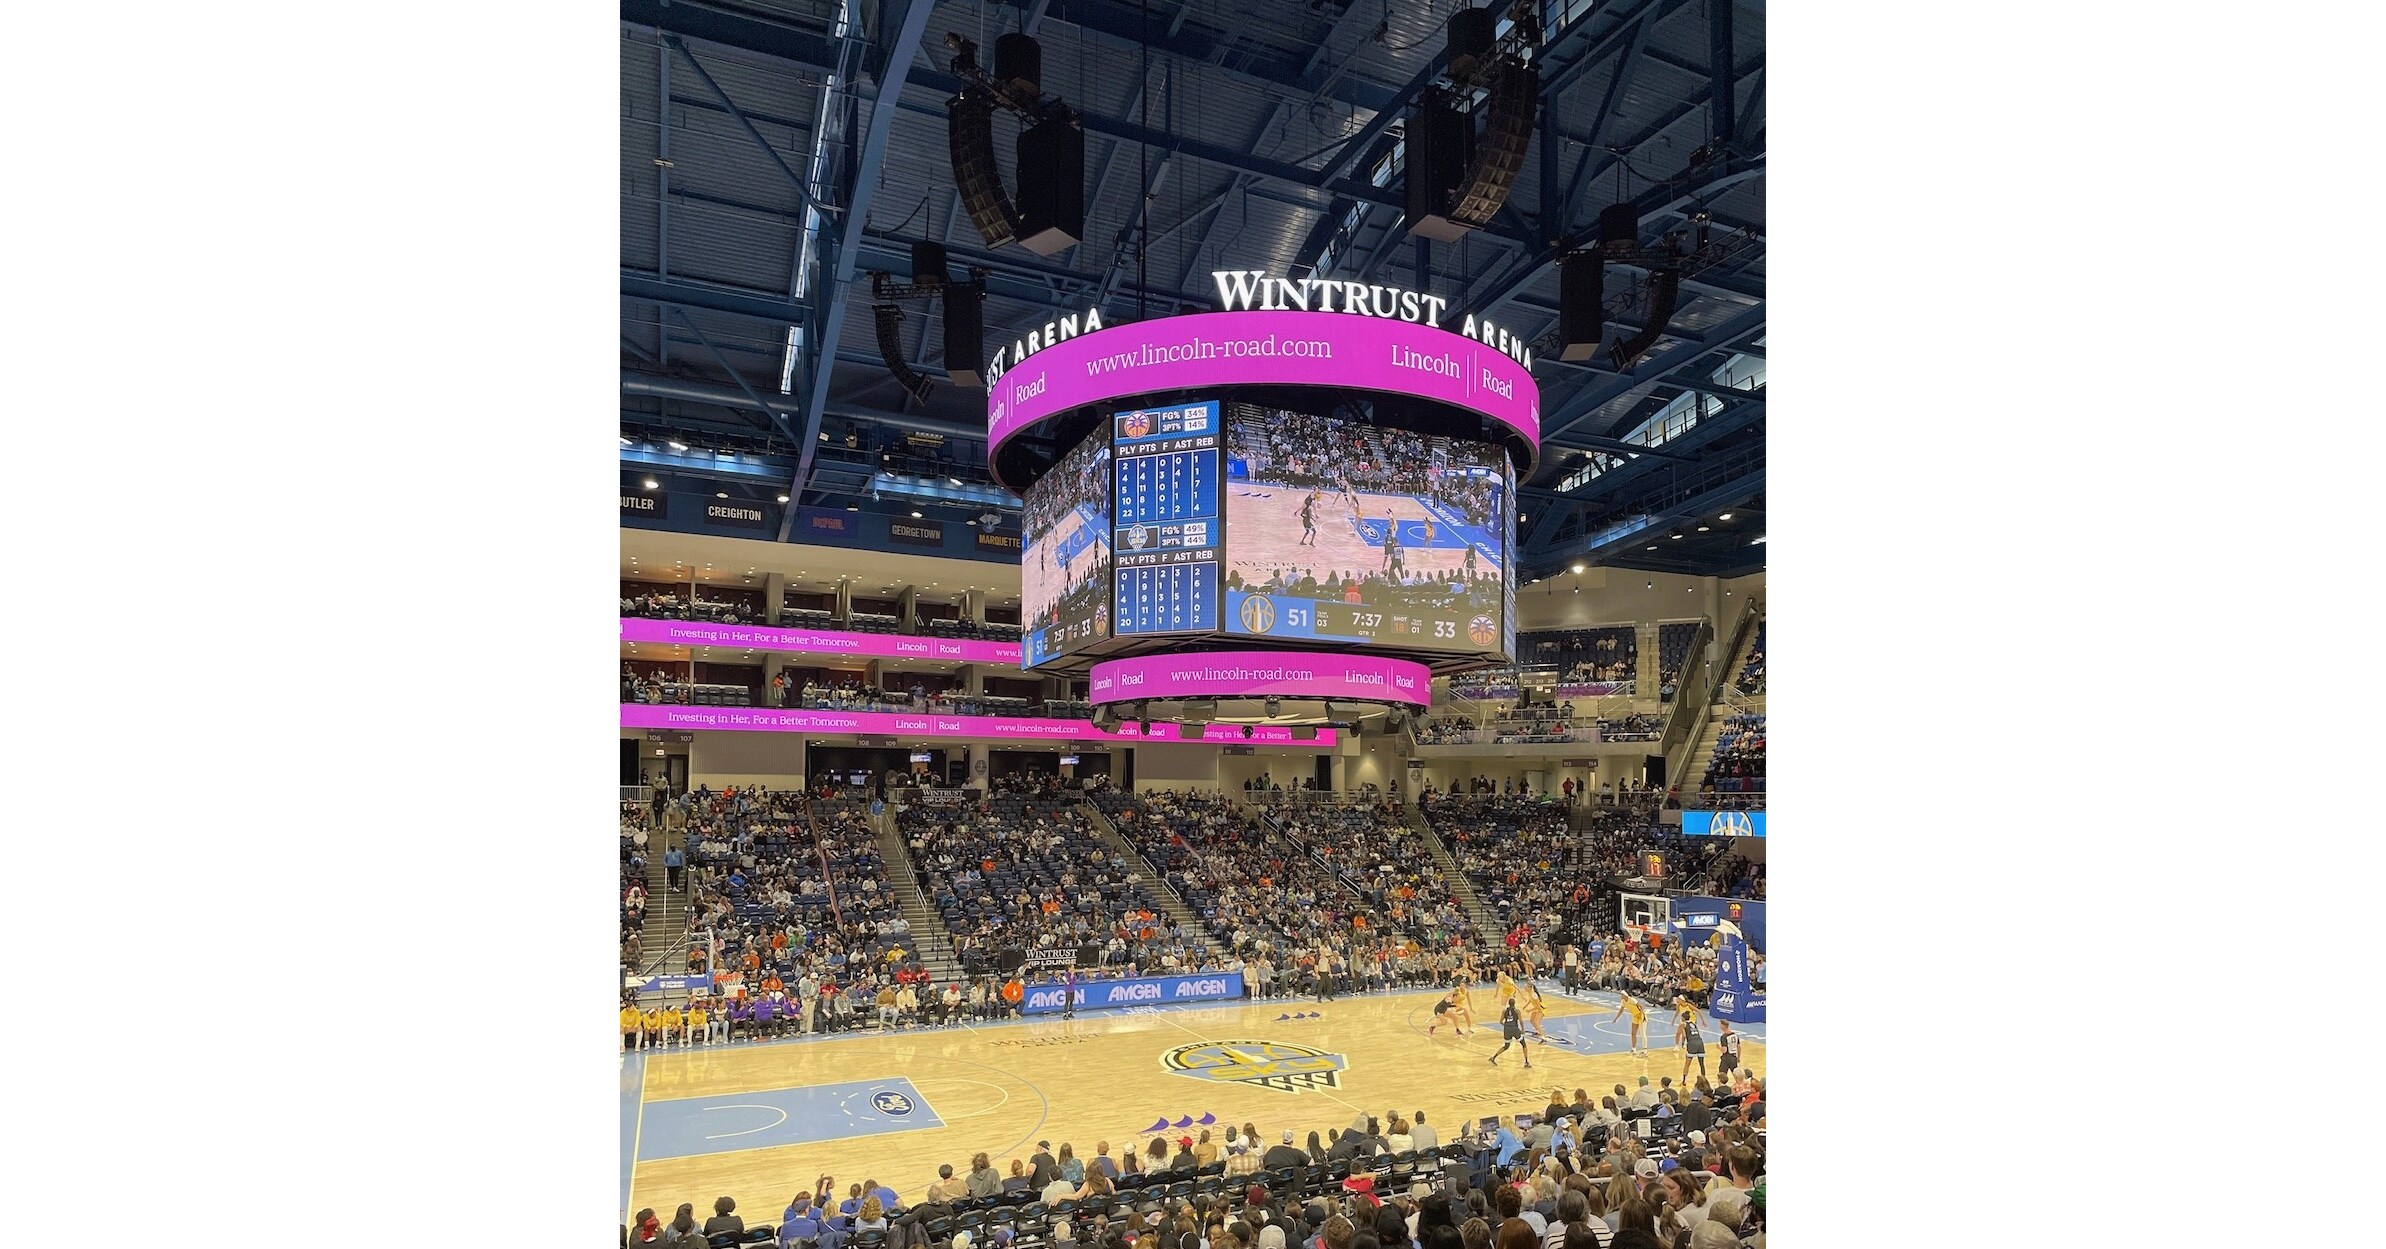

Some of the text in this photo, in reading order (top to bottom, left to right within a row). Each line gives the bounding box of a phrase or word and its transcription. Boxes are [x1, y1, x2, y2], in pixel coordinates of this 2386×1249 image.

[1212, 270, 1532, 372] WINTRUST ARENA
[1013, 307, 1103, 365] ARENA
[1086, 334, 1332, 377] www.lincoln-road.com
[1391, 344, 1513, 400] Lincoln Road
[1016, 371, 1046, 406] Road
[1162, 408, 1205, 420] FG% 34%
[1162, 421, 1205, 431] 3PT% 14%
[1120, 437, 1214, 455] PLY PTS F AST REB
[708, 505, 762, 522] CREIGHTON
[891, 524, 941, 540] GEORGETOWN
[1162, 523, 1204, 535] FG% 49%
[978, 534, 1021, 548] MARQUETTE
[1119, 550, 1213, 565] PLY PTS F AST REB
[1287, 608, 1308, 627] 51
[1316, 619, 1328, 627] 03
[1352, 612, 1382, 628] 7:37
[1081, 618, 1091, 637] 33
[1434, 620, 1456, 639] 33
[670, 628, 717, 641] Investing
[719, 630, 729, 640] in
[732, 632, 751, 642] Her,
[754, 633, 771, 642] For
[781, 634, 808, 645] Better
[811, 636, 860, 648] Tomorrow.
[896, 642, 961, 654] Lincoln Road
[1094, 670, 1144, 690] Lincoln Road
[1170, 666, 1313, 682] www.lincoln-road.com
[1345, 670, 1384, 685] Lincoln
[1396, 674, 1414, 688] Road
[668, 712, 716, 724] Investing
[718, 714, 728, 724] in
[730, 714, 750, 725] Her,
[753, 716, 770, 725] For
[779, 716, 807, 726] Better
[809, 717, 858, 727] Tomorrow.
[896, 720, 1079, 734] Lincoln Road www.lincoln-road.com
[1024, 948, 1078, 959] WINTRUST
[1735, 954, 1743, 982] HORIZON
[1028, 978, 1226, 1008] AMGN AMGEN AMGEN
